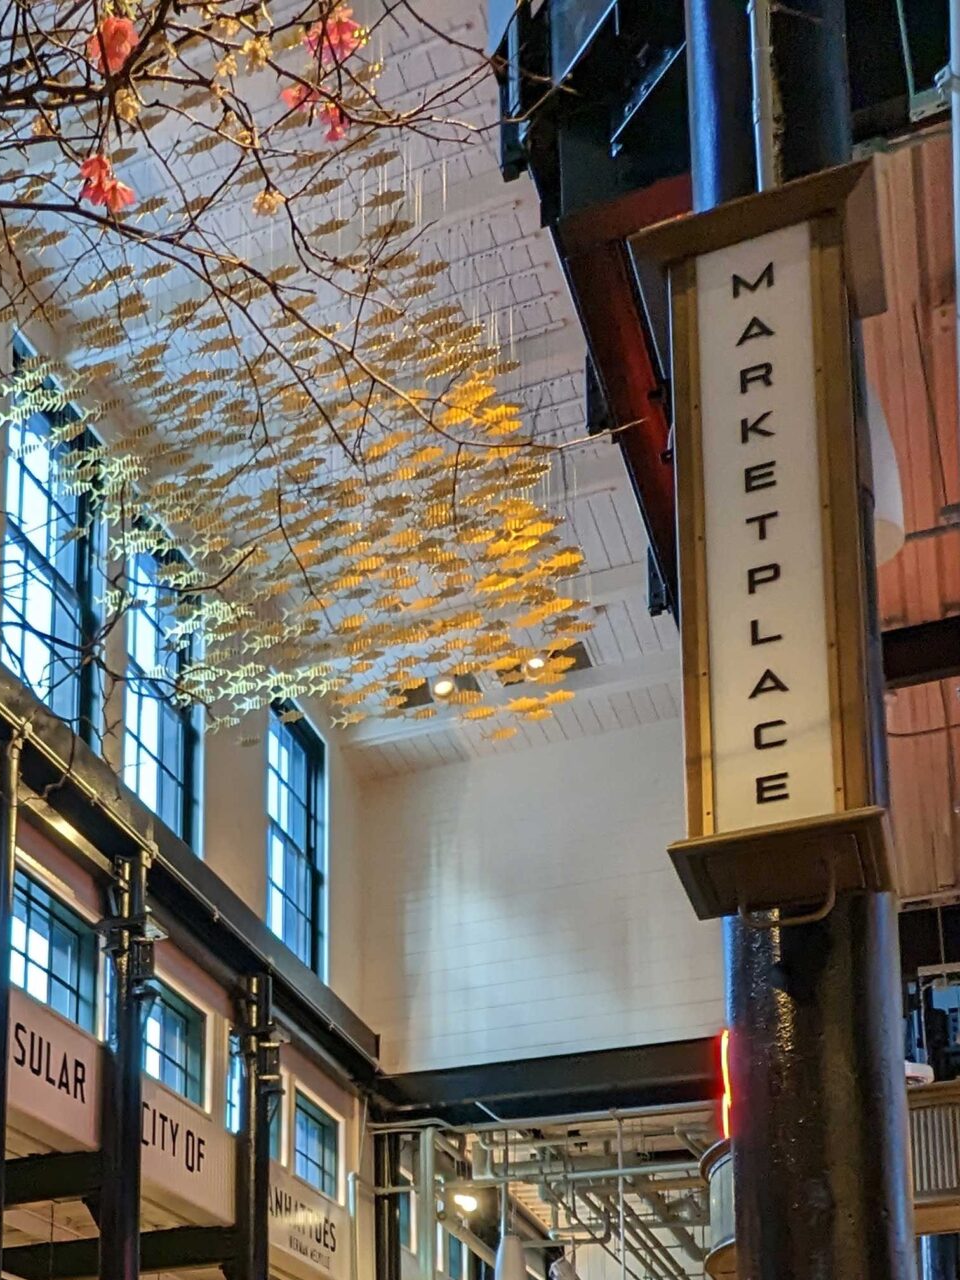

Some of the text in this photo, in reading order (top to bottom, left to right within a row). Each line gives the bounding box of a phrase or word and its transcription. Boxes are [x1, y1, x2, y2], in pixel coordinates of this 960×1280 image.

[731, 260, 790, 806] MARKETPLACE
[13, 1021, 87, 1105] SULAR
[141, 1100, 207, 1174] CITY OF
